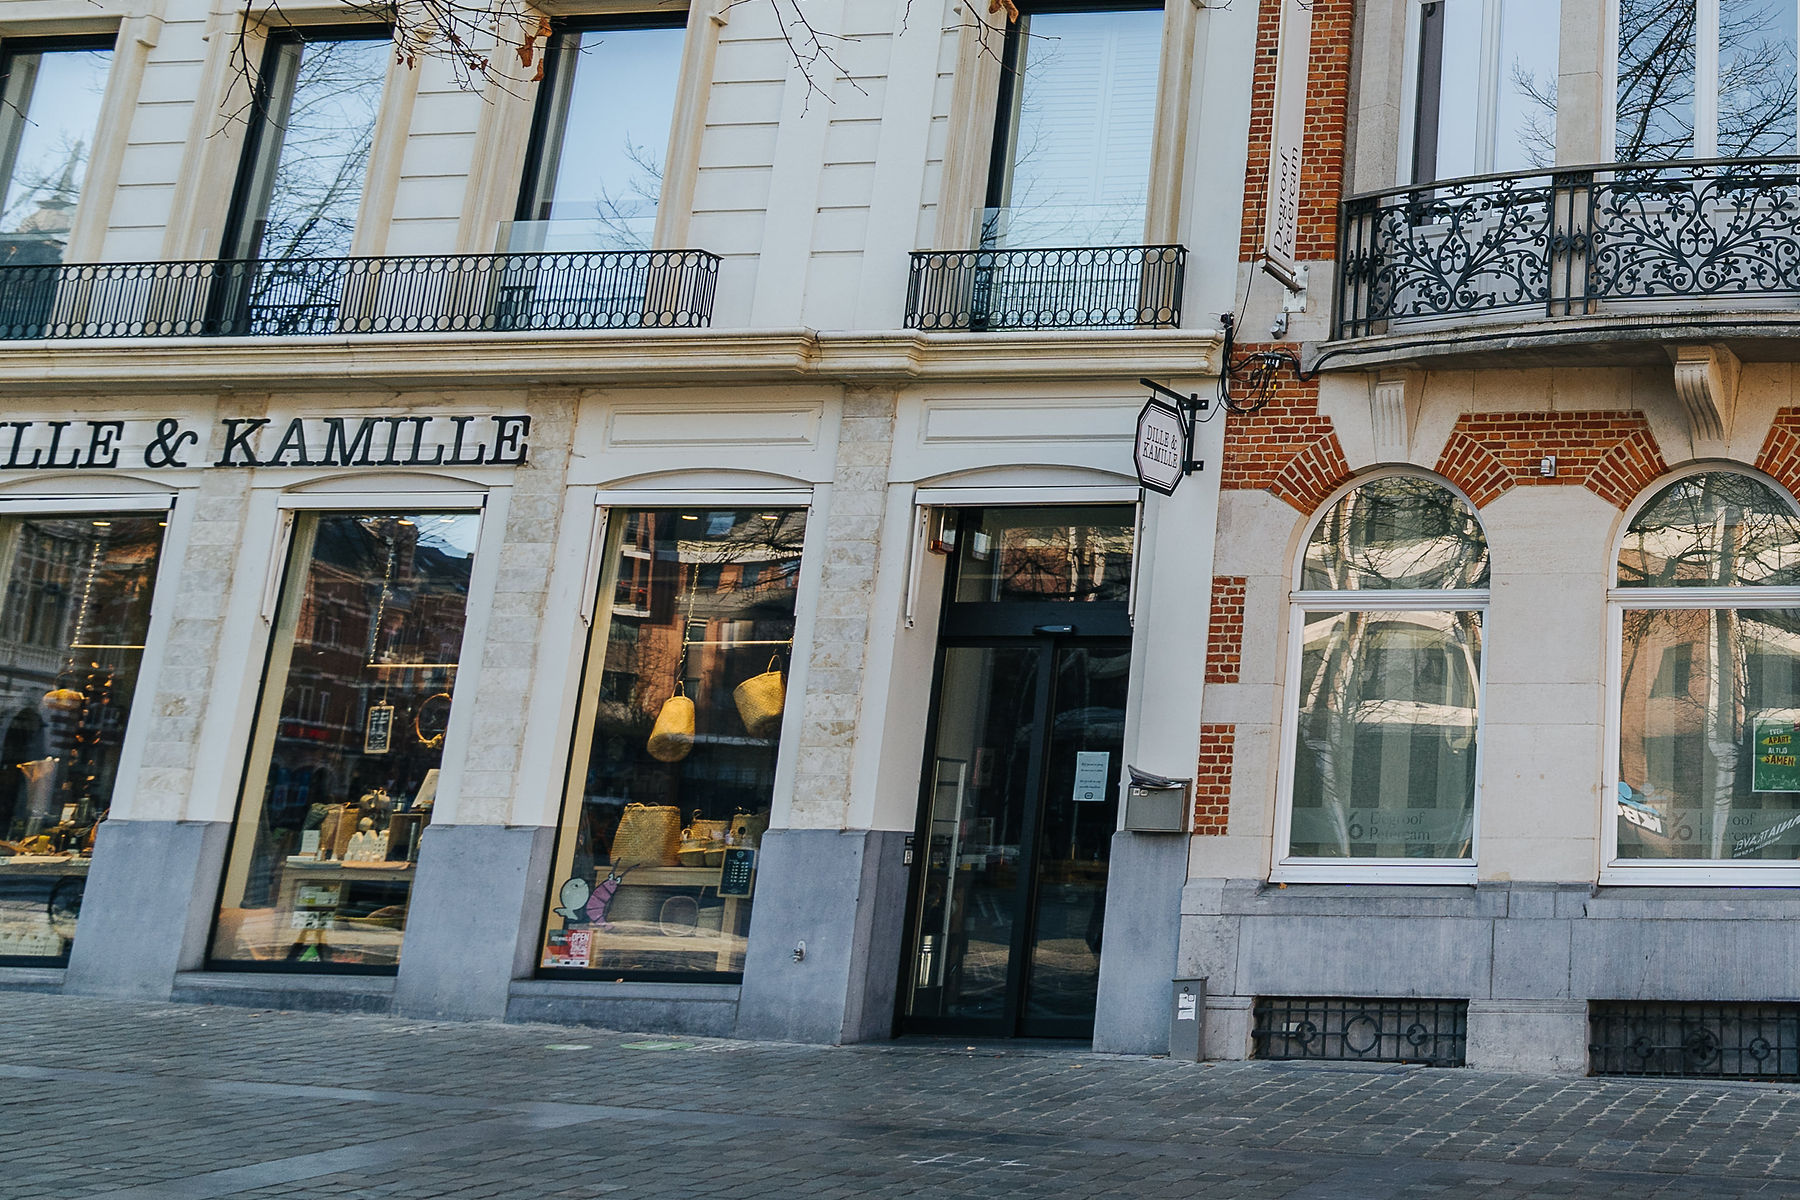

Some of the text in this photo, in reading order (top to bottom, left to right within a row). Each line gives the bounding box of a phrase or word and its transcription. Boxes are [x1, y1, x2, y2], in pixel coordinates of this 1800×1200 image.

[1274, 146, 1289, 253] Degroof
[1283, 147, 1299, 259] Petercam
[0, 415, 532, 469] LLE & KAMILLE
[1146, 424, 1178, 450] DILLE &
[1142, 441, 1178, 468] KAMILLE
[1769, 728, 1784, 736] EVEN
[1765, 755, 1795, 766] SAMEN
